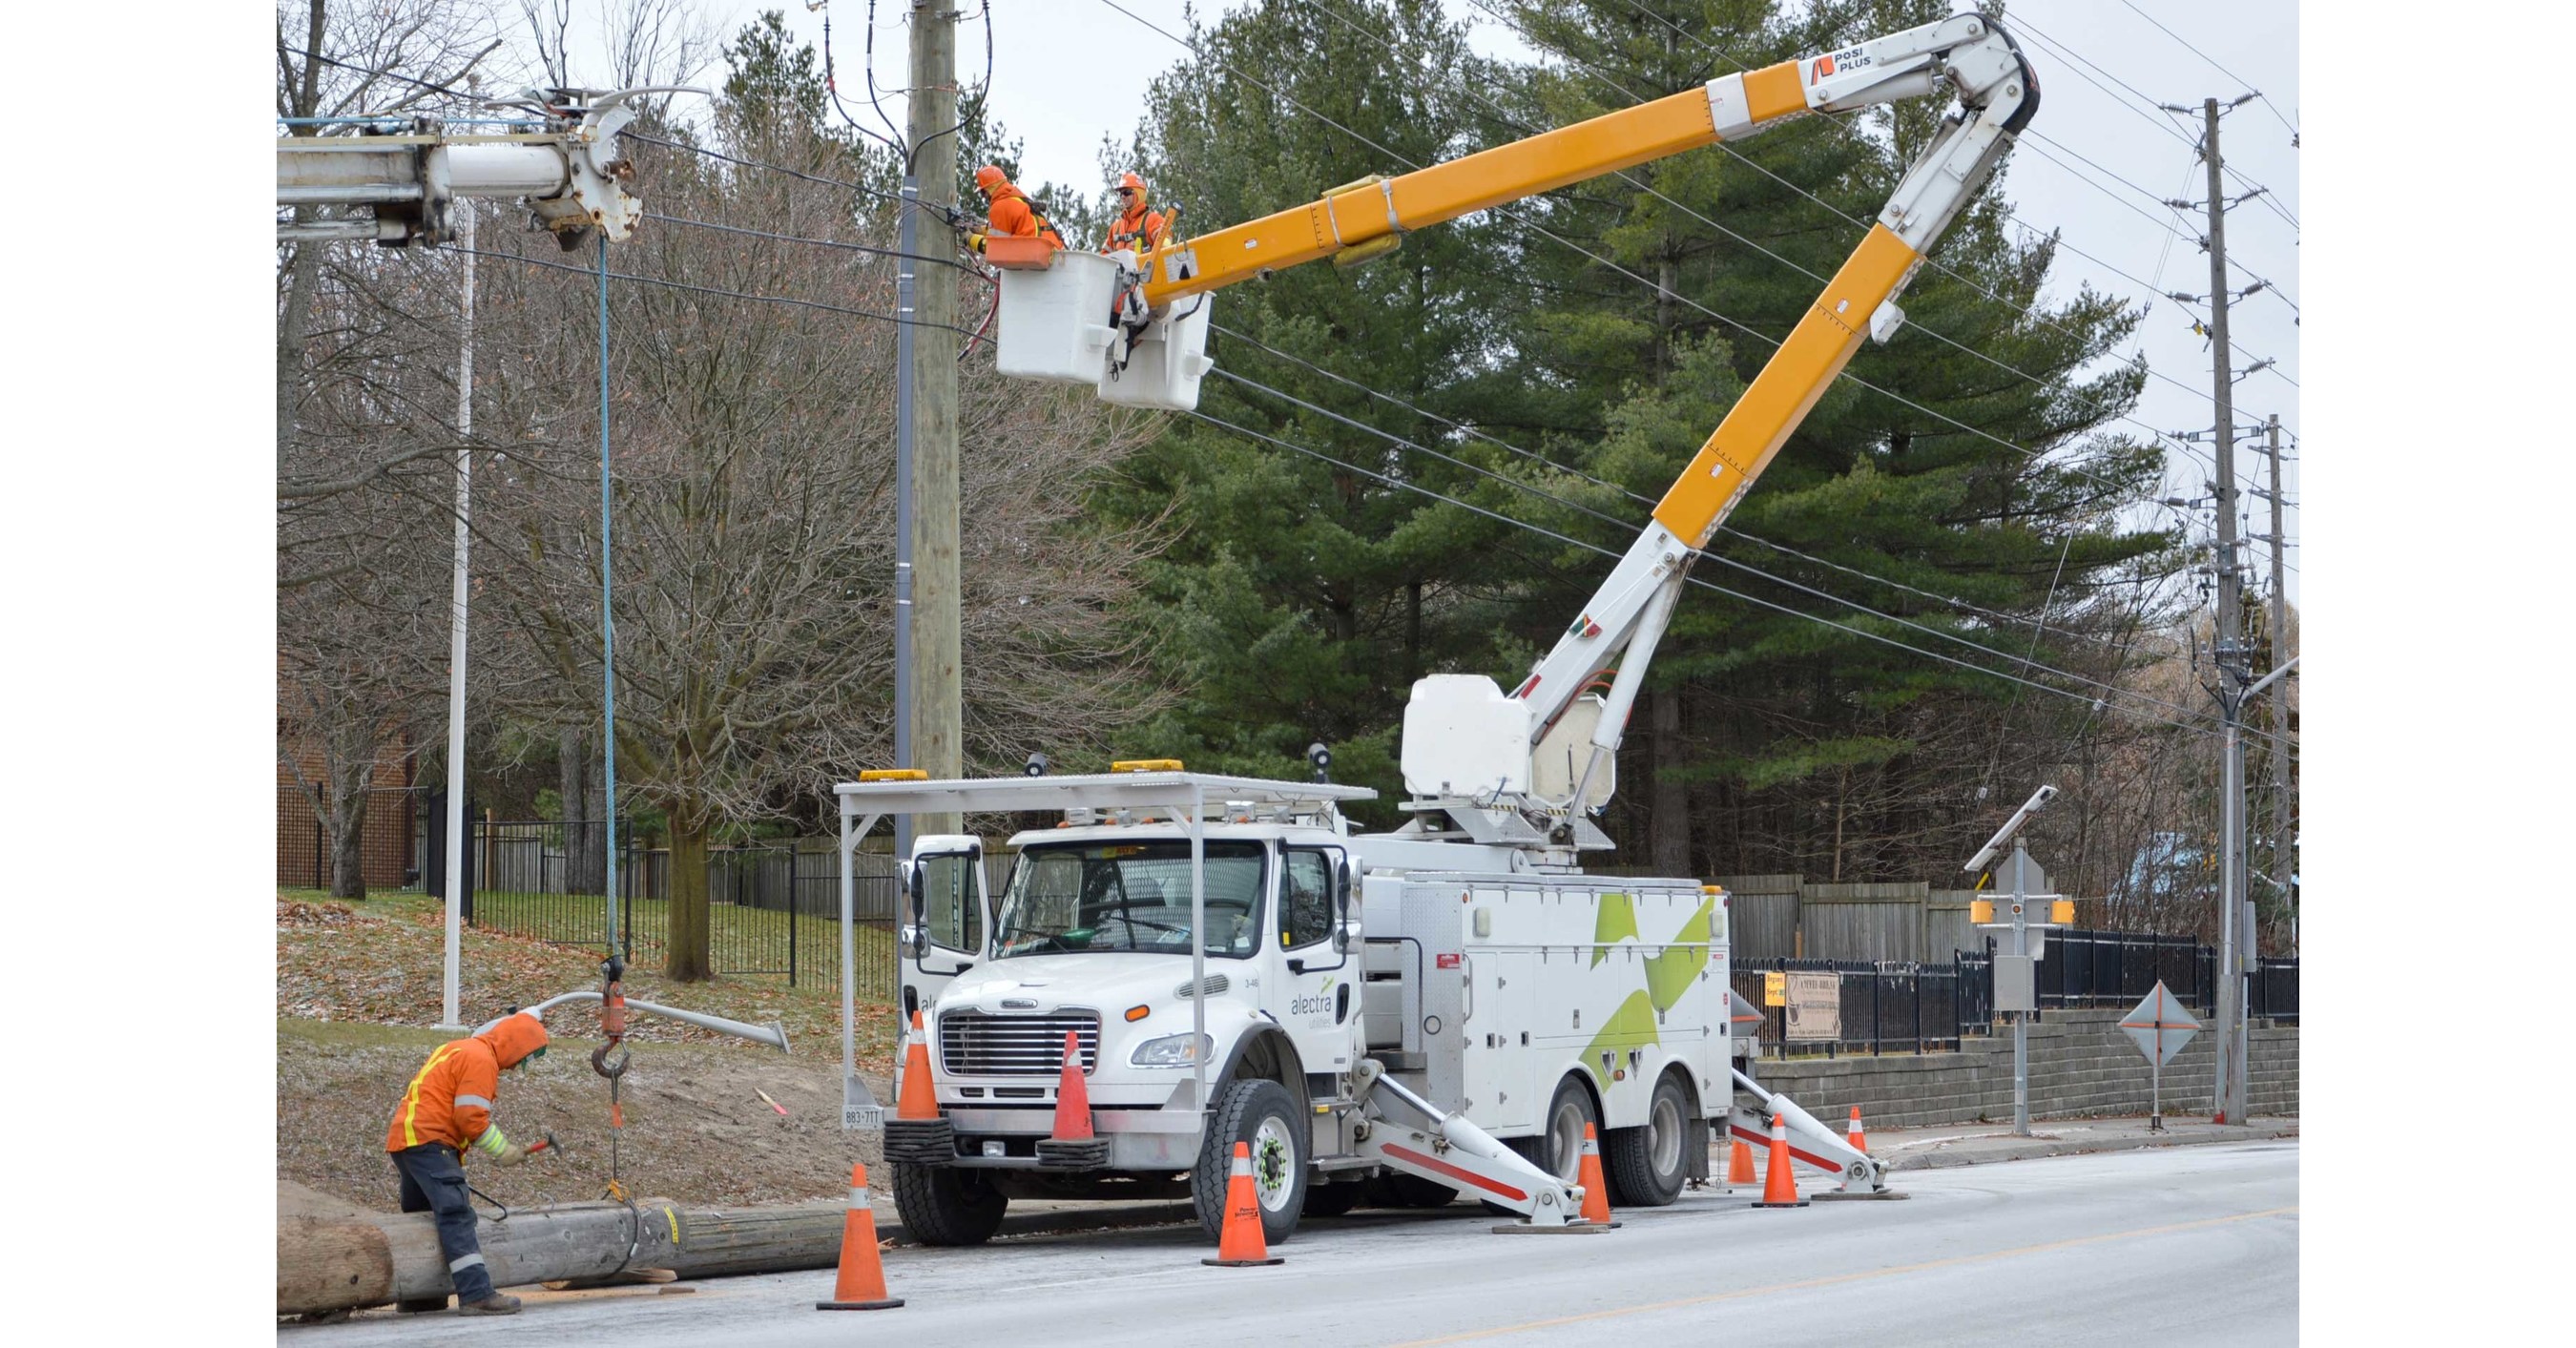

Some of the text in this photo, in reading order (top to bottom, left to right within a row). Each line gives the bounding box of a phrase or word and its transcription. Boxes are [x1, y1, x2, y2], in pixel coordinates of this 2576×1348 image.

[1835, 48, 1862, 63] POSI
[1840, 57, 1871, 73] PLUS
[1291, 994, 1331, 1015] alectra
